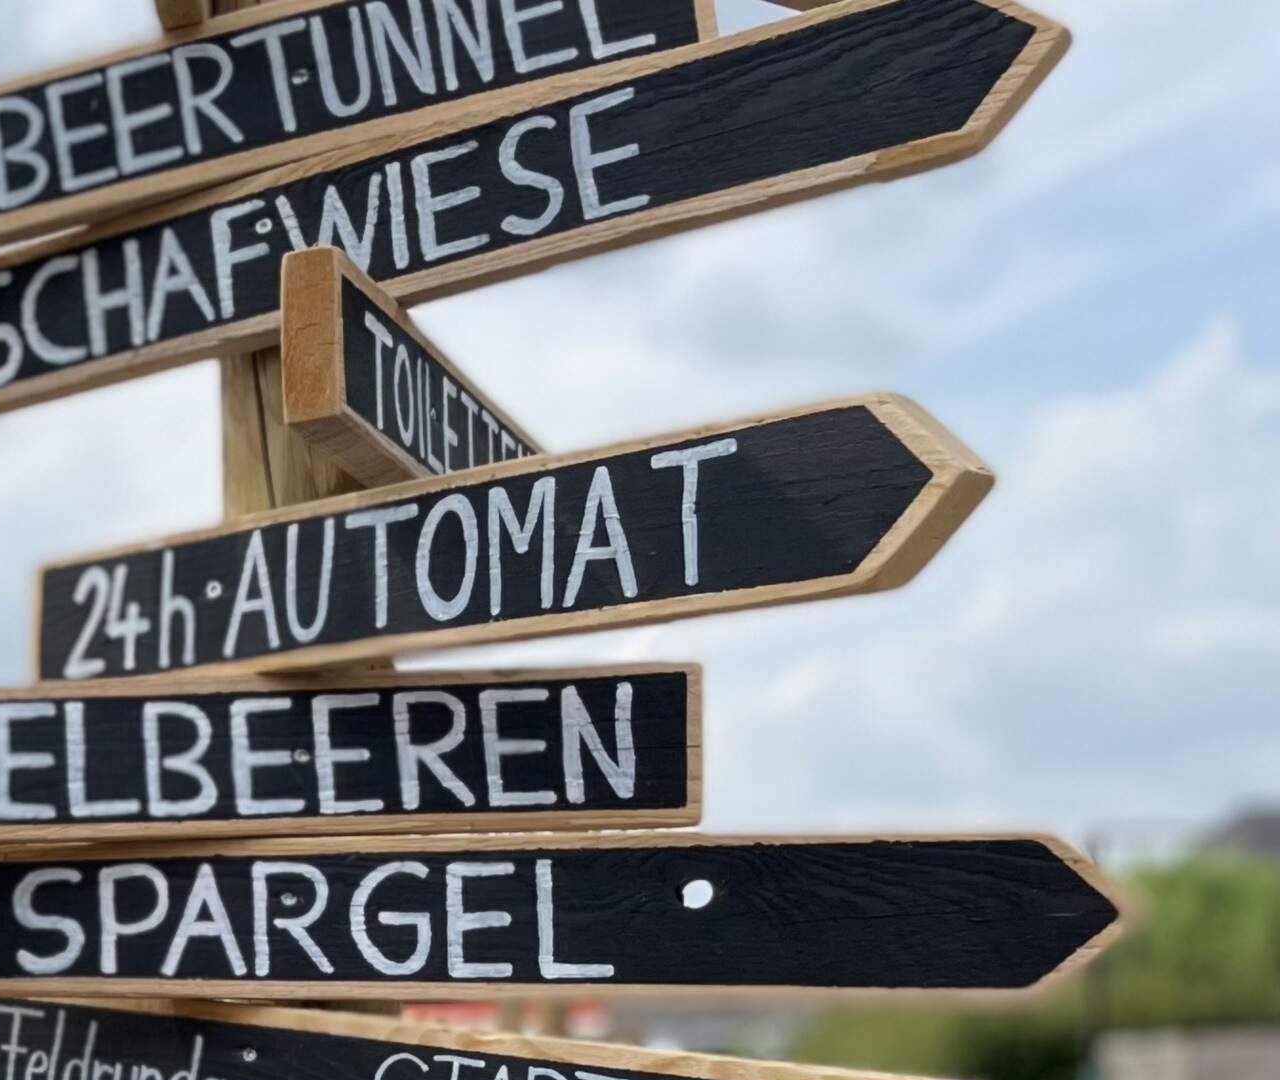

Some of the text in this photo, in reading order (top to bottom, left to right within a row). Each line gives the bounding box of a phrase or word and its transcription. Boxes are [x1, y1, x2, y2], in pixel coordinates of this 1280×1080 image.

[364, 310, 532, 475] TOILETT
[64, 438, 737, 678] 24h AUTOMAT
[13, 858, 615, 980] SPARGEL
